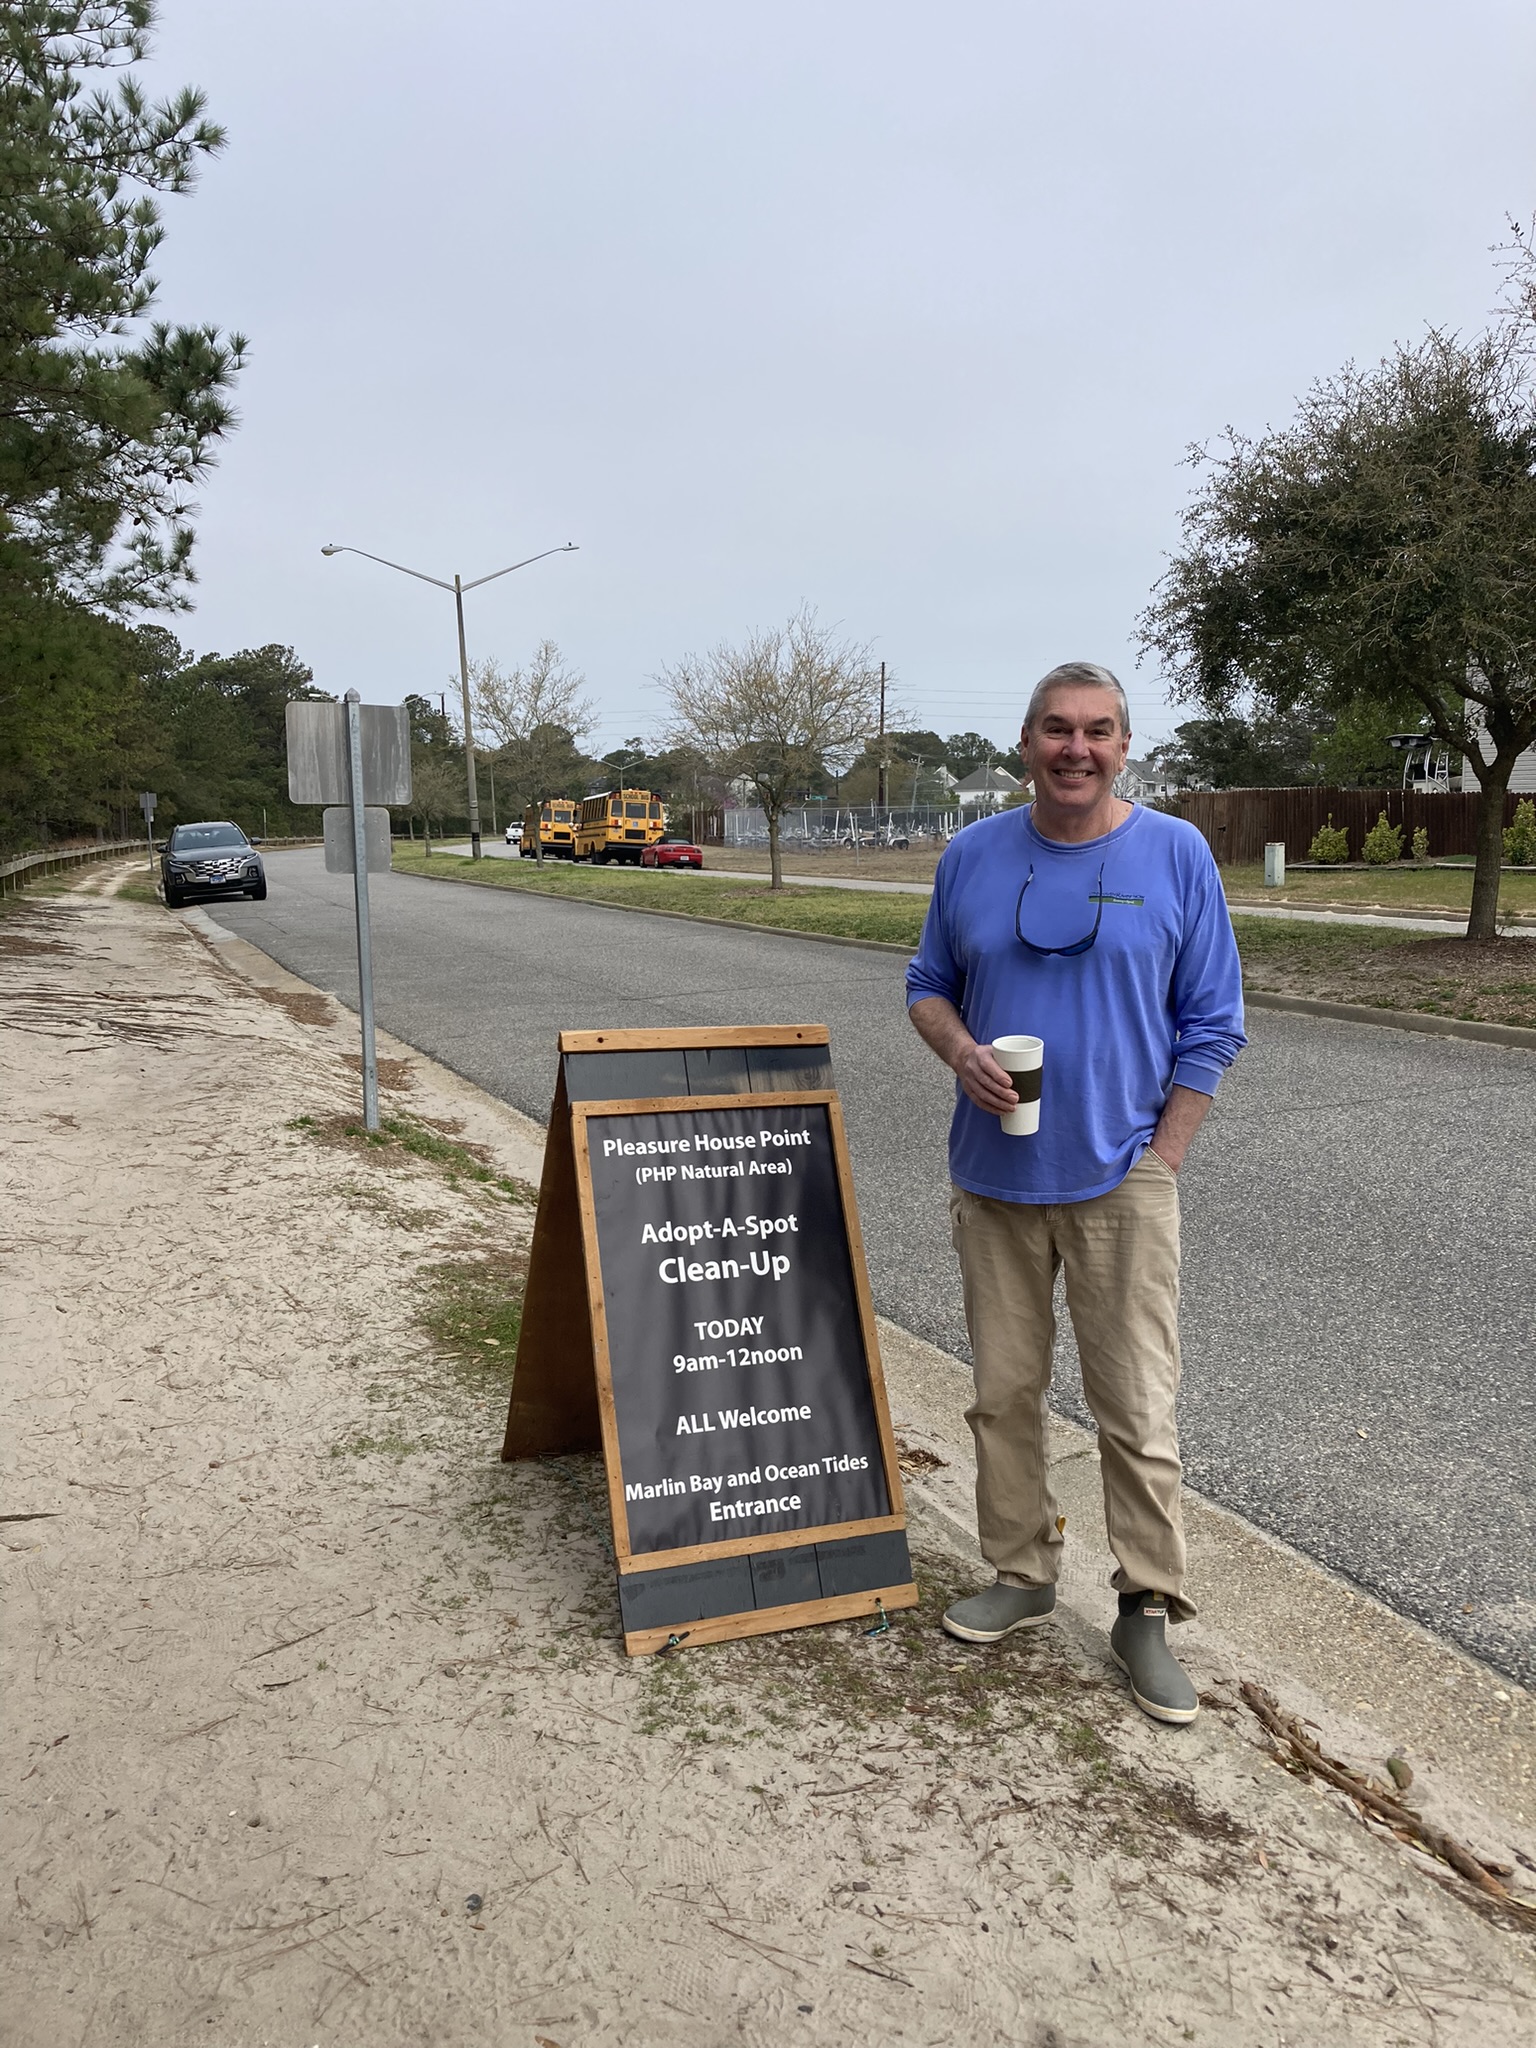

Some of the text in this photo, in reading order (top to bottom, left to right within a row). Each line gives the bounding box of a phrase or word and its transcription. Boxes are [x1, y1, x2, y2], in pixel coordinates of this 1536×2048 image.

[602, 1129, 812, 1157] Pleasure House Point
[635, 1158, 793, 1186] (PHP Natural Area)
[641, 1213, 799, 1246] Adopt-A-Spot
[658, 1250, 791, 1284] Clean-Up
[693, 1315, 764, 1341] TODAY
[673, 1345, 803, 1374] 9am-12noon
[676, 1405, 812, 1436] ALL Welcome
[625, 1454, 869, 1502] Marlin Bay and Ocean Tides
[709, 1495, 802, 1522] Entrance
